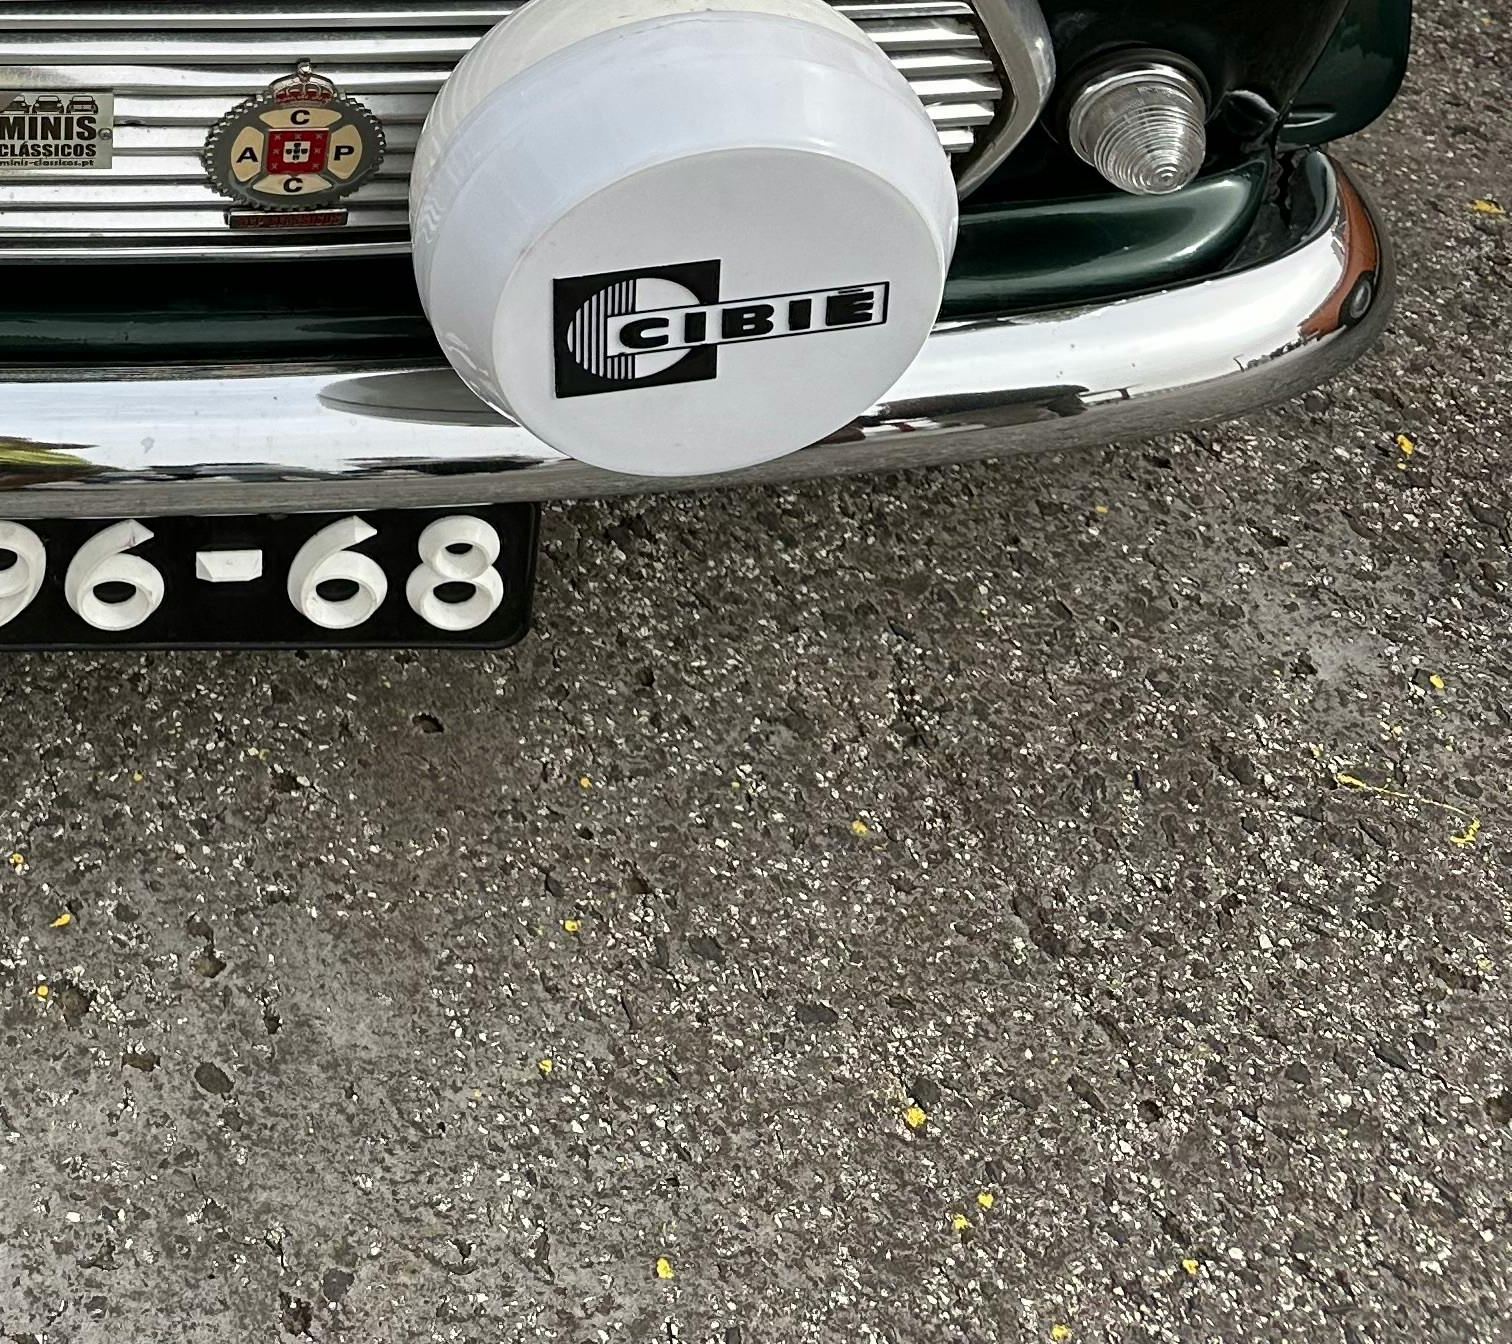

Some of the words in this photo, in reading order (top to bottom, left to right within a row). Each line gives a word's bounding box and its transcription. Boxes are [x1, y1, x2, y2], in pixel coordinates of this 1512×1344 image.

[290, 109, 311, 126] C
[236, 146, 259, 163] A
[333, 145, 355, 161] P
[283, 177, 303, 193] C
